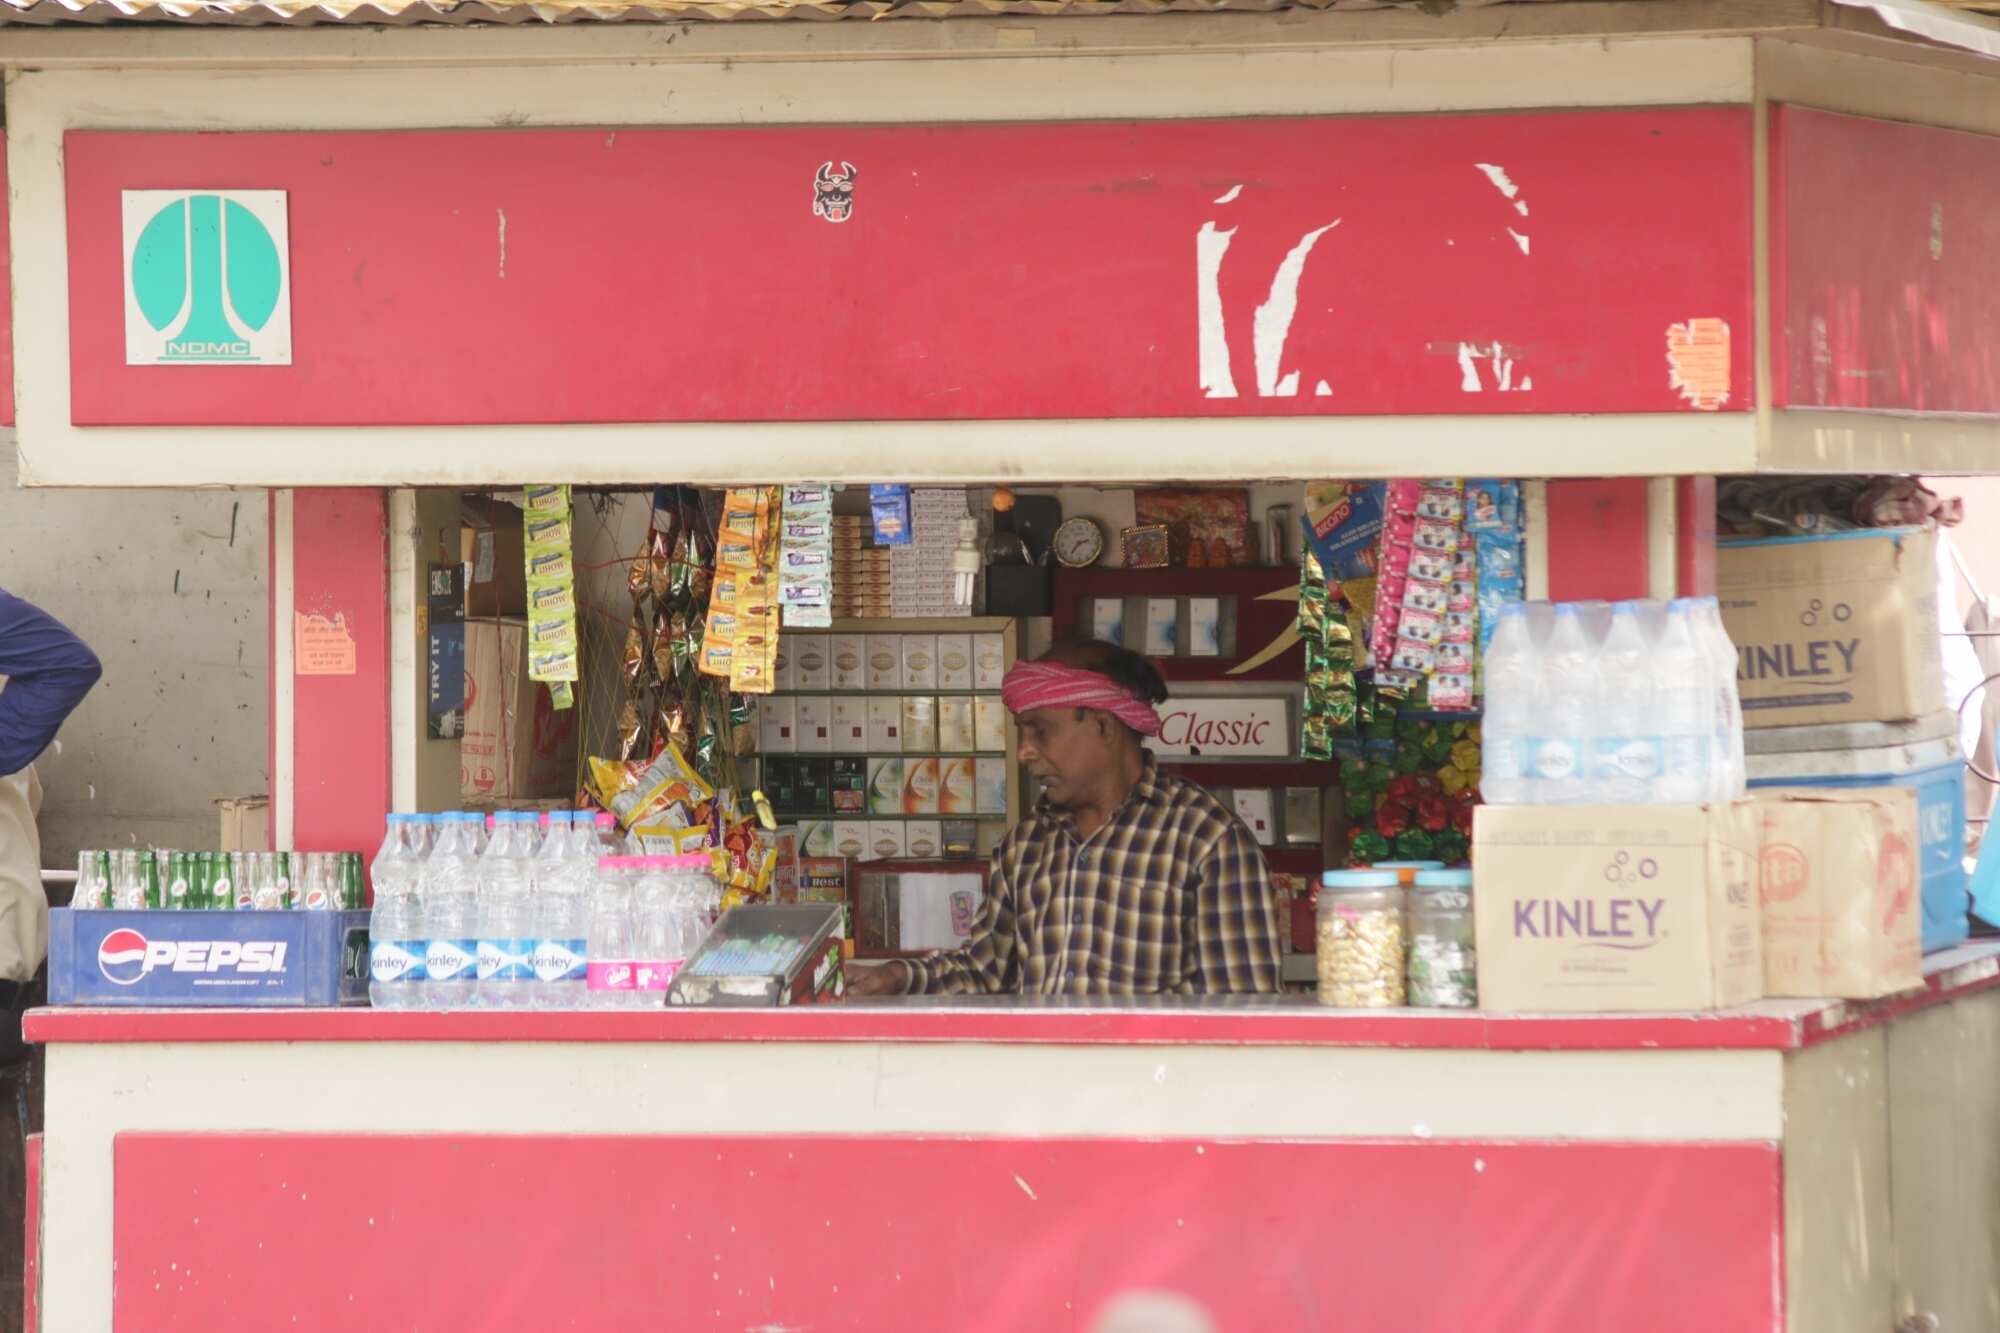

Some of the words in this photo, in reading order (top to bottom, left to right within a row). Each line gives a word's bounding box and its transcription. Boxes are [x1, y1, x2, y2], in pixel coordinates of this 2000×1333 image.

[167, 342, 249, 355] NDMC
[431, 635, 440, 653] IT
[1737, 638, 1861, 680] INLEY
[431, 662, 440, 702] TRY
[1159, 711, 1271, 746] Classic
[1513, 899, 1665, 938] KINLEY
[142, 941, 288, 972] PEPSI
[427, 954, 463, 968] kinley
